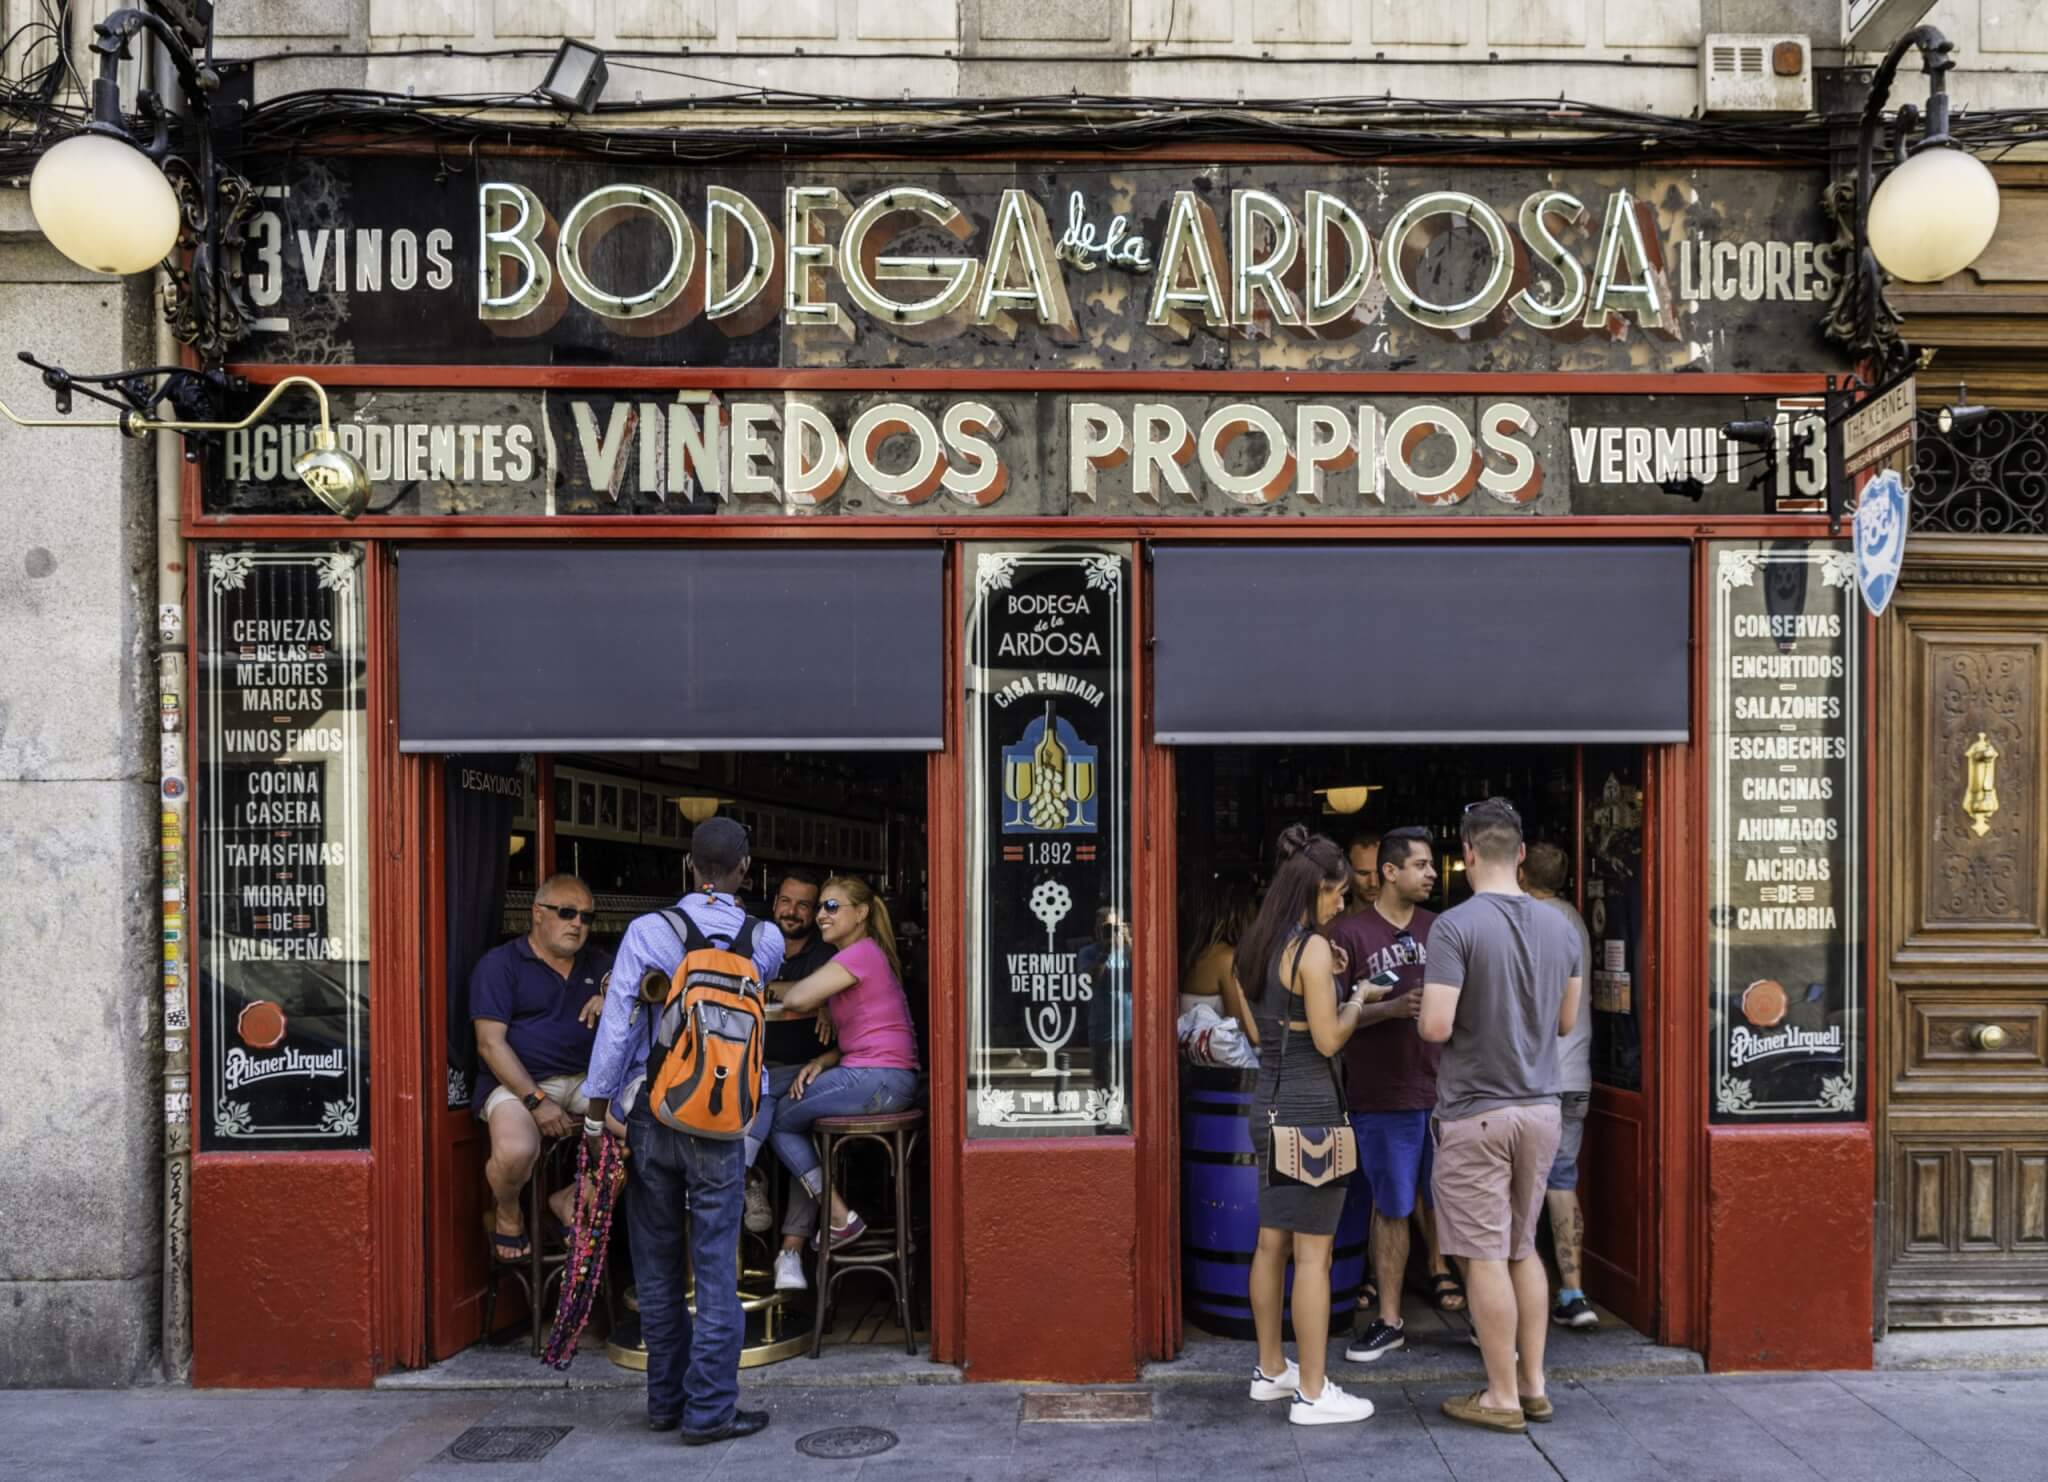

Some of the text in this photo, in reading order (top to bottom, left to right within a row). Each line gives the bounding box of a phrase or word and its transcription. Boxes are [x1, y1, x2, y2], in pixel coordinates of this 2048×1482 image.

[234, 210, 282, 306] 3
[299, 229, 453, 291] VINOS
[479, 184, 1665, 328] BODEGA de la ARDOSA
[1680, 240, 1836, 300] LICORES
[1847, 412, 1865, 443] THE
[1867, 387, 1909, 426] KERNEL
[226, 424, 533, 481] AGURDIENTES
[571, 389, 1536, 497] VIÑEDOS PROPIOS
[1775, 412, 1828, 497] 13
[1571, 427, 1740, 484] VERMUT
[1008, 594, 1090, 614] BODEGA
[233, 619, 332, 642] CERVEZAS
[1034, 615, 1064, 632] de la
[1734, 614, 1841, 637] CONSERVAS
[257, 645, 307, 662] DE LAS
[998, 632, 1101, 656] ARDOSA
[237, 663, 328, 686] MEJORES
[1732, 655, 1843, 679] ENCURTIDOS
[243, 688, 323, 711] MARCAS
[994, 671, 1105, 709] CASA FUNDADA
[1735, 696, 1840, 719] SALAZONES
[225, 728, 342, 752] VINOS FINOS
[1730, 736, 1846, 760] ESCABECHES
[249, 771, 318, 794] COCINA
[462, 768, 522, 798] DESAYUNOS
[1743, 777, 1832, 801] CHACINAS
[246, 801, 321, 824] CASERA
[1737, 818, 1837, 841] AHUMADOS
[226, 843, 344, 866] TAPAS FINAS
[1028, 842, 1072, 865] 1.892
[1745, 858, 1830, 881] ANCHOAS
[243, 884, 325, 907] MORAPIO
[1777, 884, 1797, 904] DE
[272, 913, 292, 931] DE
[1737, 907, 1837, 930] CANTABRIA
[229, 932, 343, 961] VALDEPEÑAS
[1007, 953, 1077, 974] VERMUT
[1011, 973, 1093, 1002] DE REUS
[1730, 1024, 1840, 1068] Pilsner Urquell
[225, 1046, 343, 1090] Pilsner Urquell
